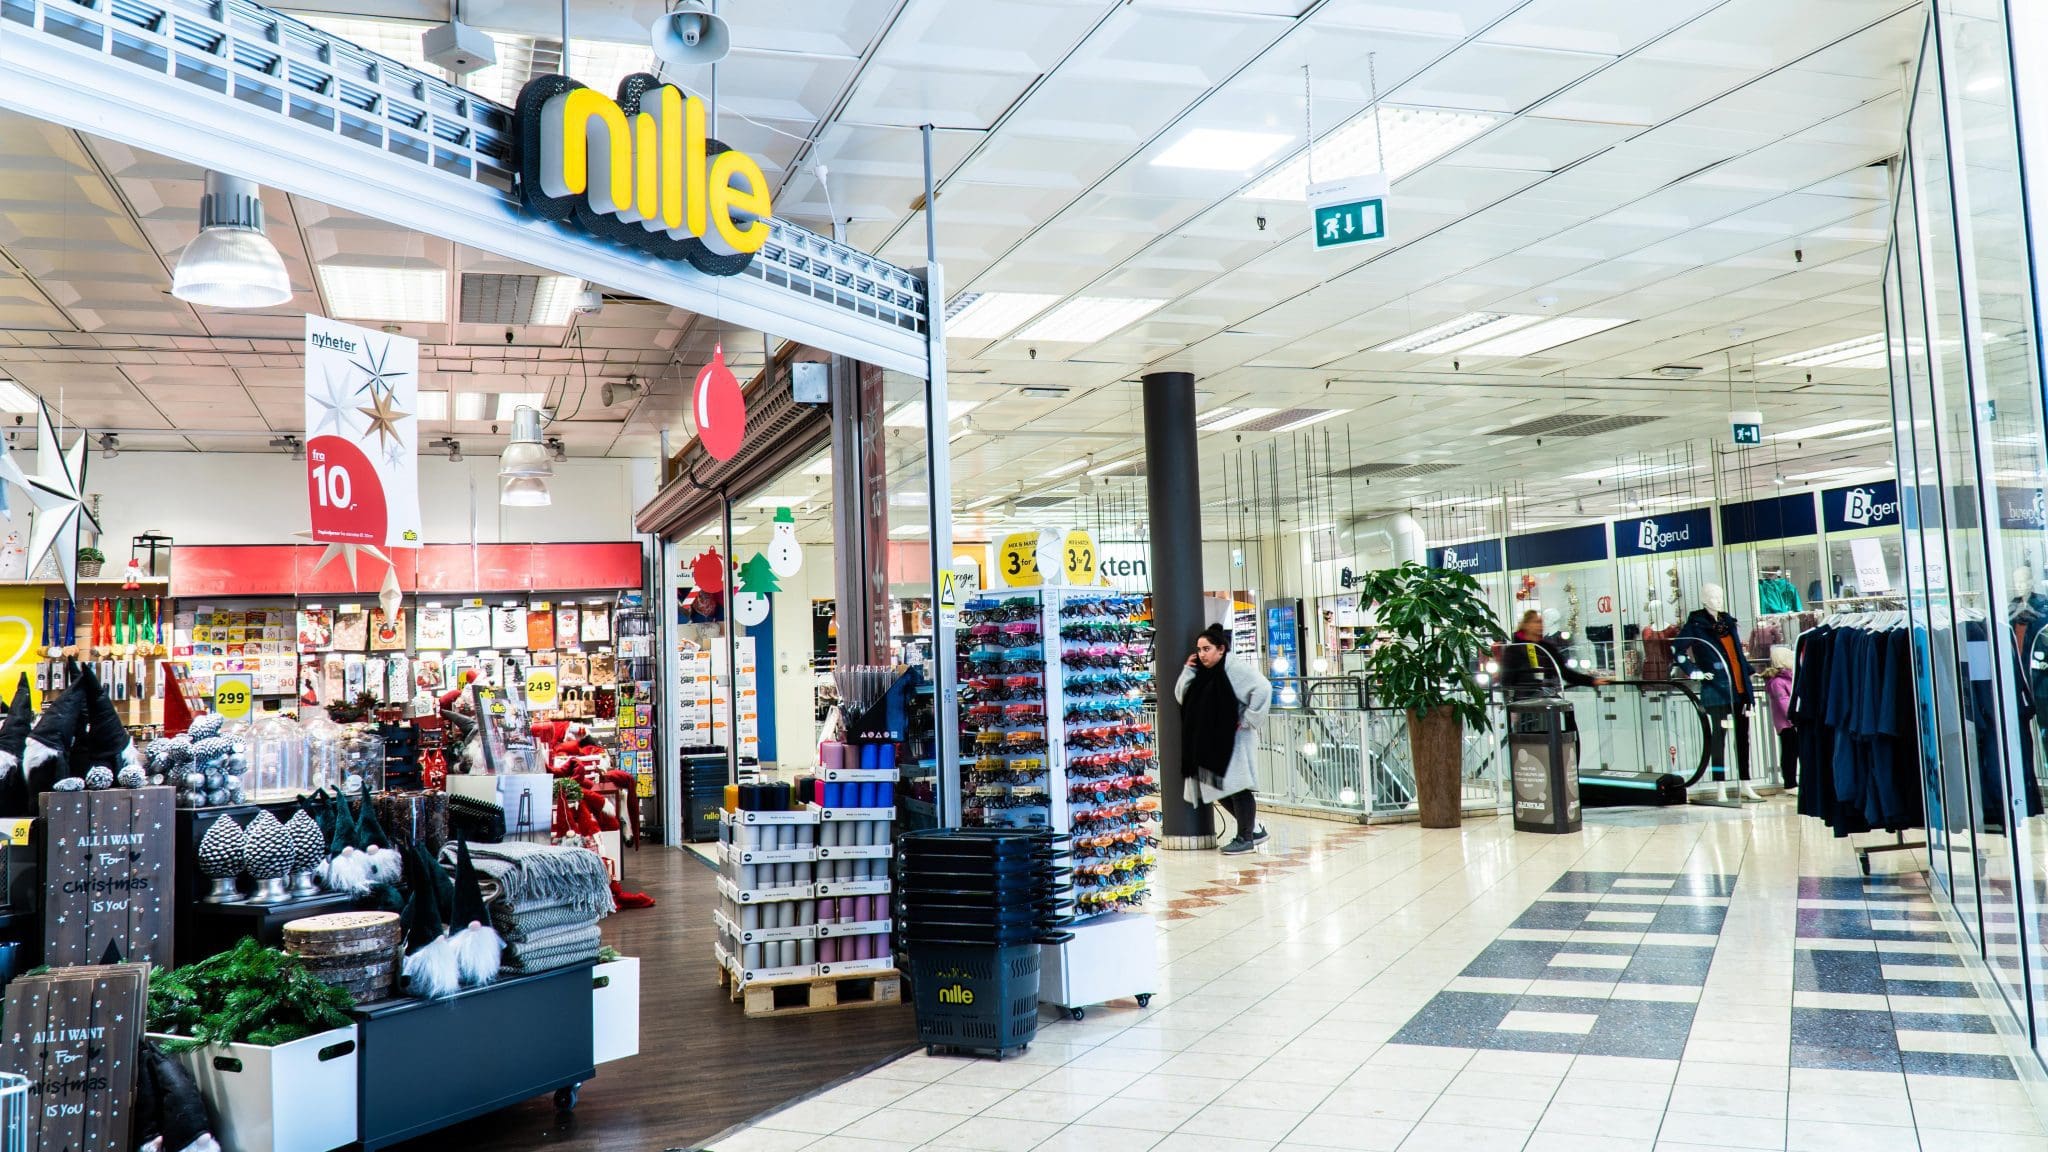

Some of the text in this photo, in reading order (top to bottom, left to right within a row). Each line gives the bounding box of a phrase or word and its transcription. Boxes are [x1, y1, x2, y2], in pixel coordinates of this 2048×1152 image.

[561, 84, 771, 254] nille
[312, 331, 357, 351] nyheter
[312, 448, 325, 461] fra
[1644, 524, 1689, 547] Bogerud
[1008, 551, 1021, 575] 3
[1021, 558, 1032, 566] for
[1068, 548, 1077, 572] 3
[1082, 549, 1092, 572] 2
[1447, 552, 1479, 572] Bogerud
[528, 681, 551, 692] 249
[218, 692, 245, 704] 299
[77, 833, 144, 847] ALL I WANT
[99, 853, 126, 866] For
[939, 984, 974, 1004] nille
[32, 1026, 105, 1044] ALL I WANT
[54, 1049, 83, 1064] For
[28, 1076, 107, 1097] hristmas
